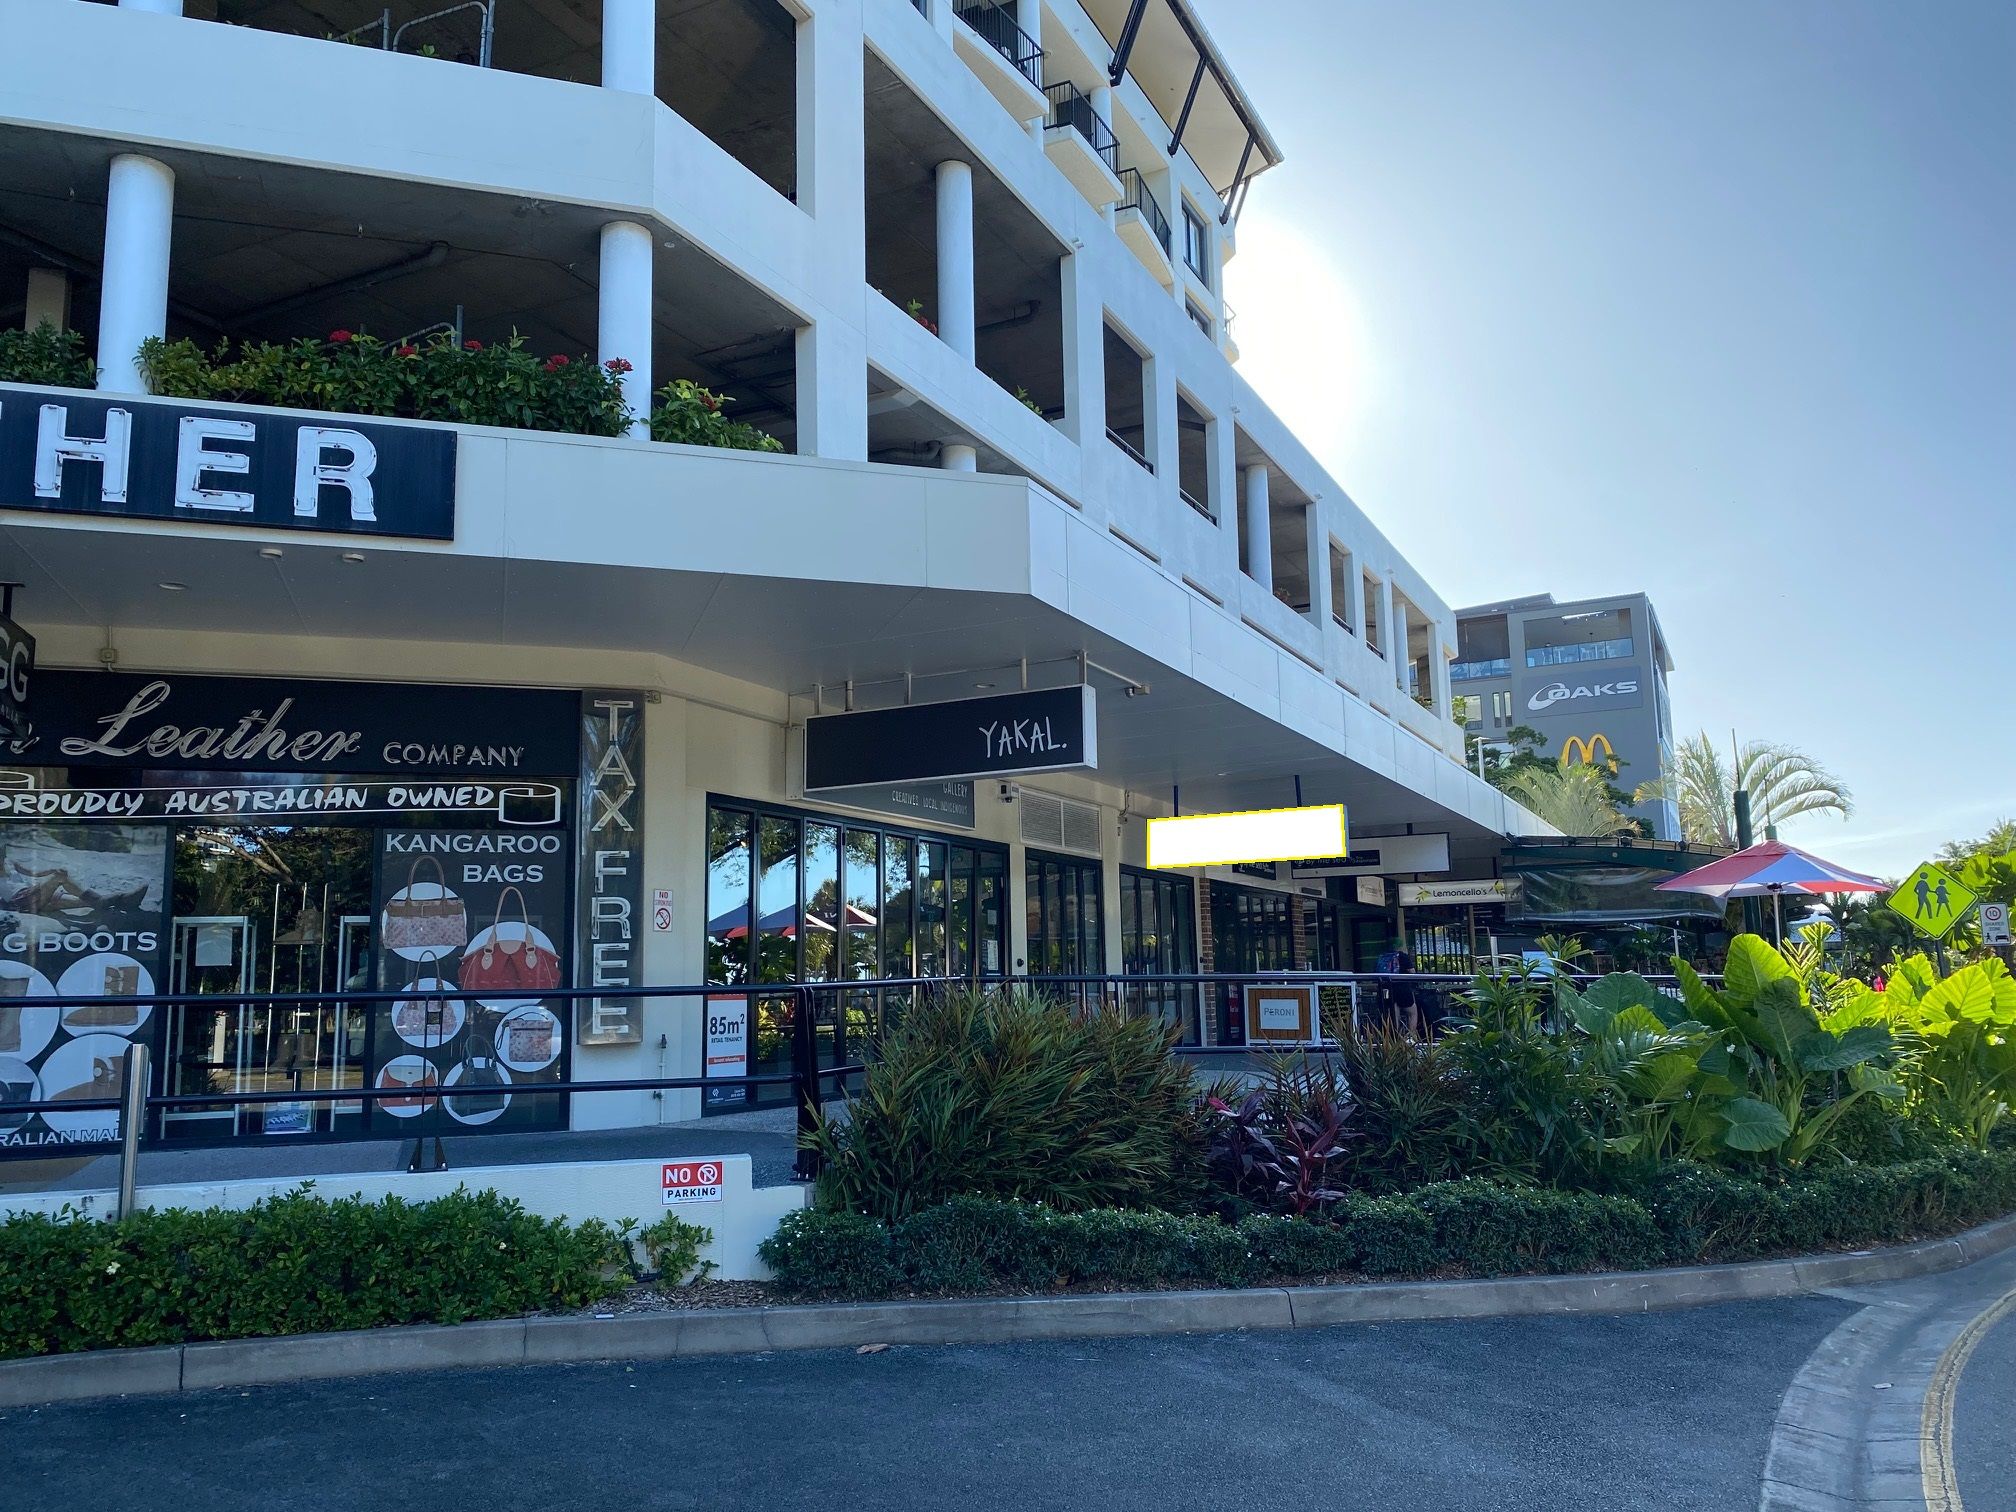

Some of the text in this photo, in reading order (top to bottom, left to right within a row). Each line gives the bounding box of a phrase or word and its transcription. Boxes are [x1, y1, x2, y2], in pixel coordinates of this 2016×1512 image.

[0, 403, 378, 522] HER
[1547, 681, 1638, 700] OAKS
[60, 680, 362, 761] Leather
[382, 741, 525, 767] COMPANY
[978, 716, 1067, 759] YAKAL.
[164, 787, 368, 814] AUSTRALIAN
[387, 786, 495, 807] OWNED
[385, 833, 561, 853] KANGAROO
[462, 864, 544, 883] BAGS
[590, 699, 637, 1035] TAX FREE
[658, 891, 669, 899] NO
[1432, 888, 1488, 898] Lemoncello's
[38, 931, 158, 952] BOOTS
[1263, 1007, 1295, 1016] PERONI
[665, 1167, 691, 1184] NO
[667, 1187, 716, 1199] PARKING
